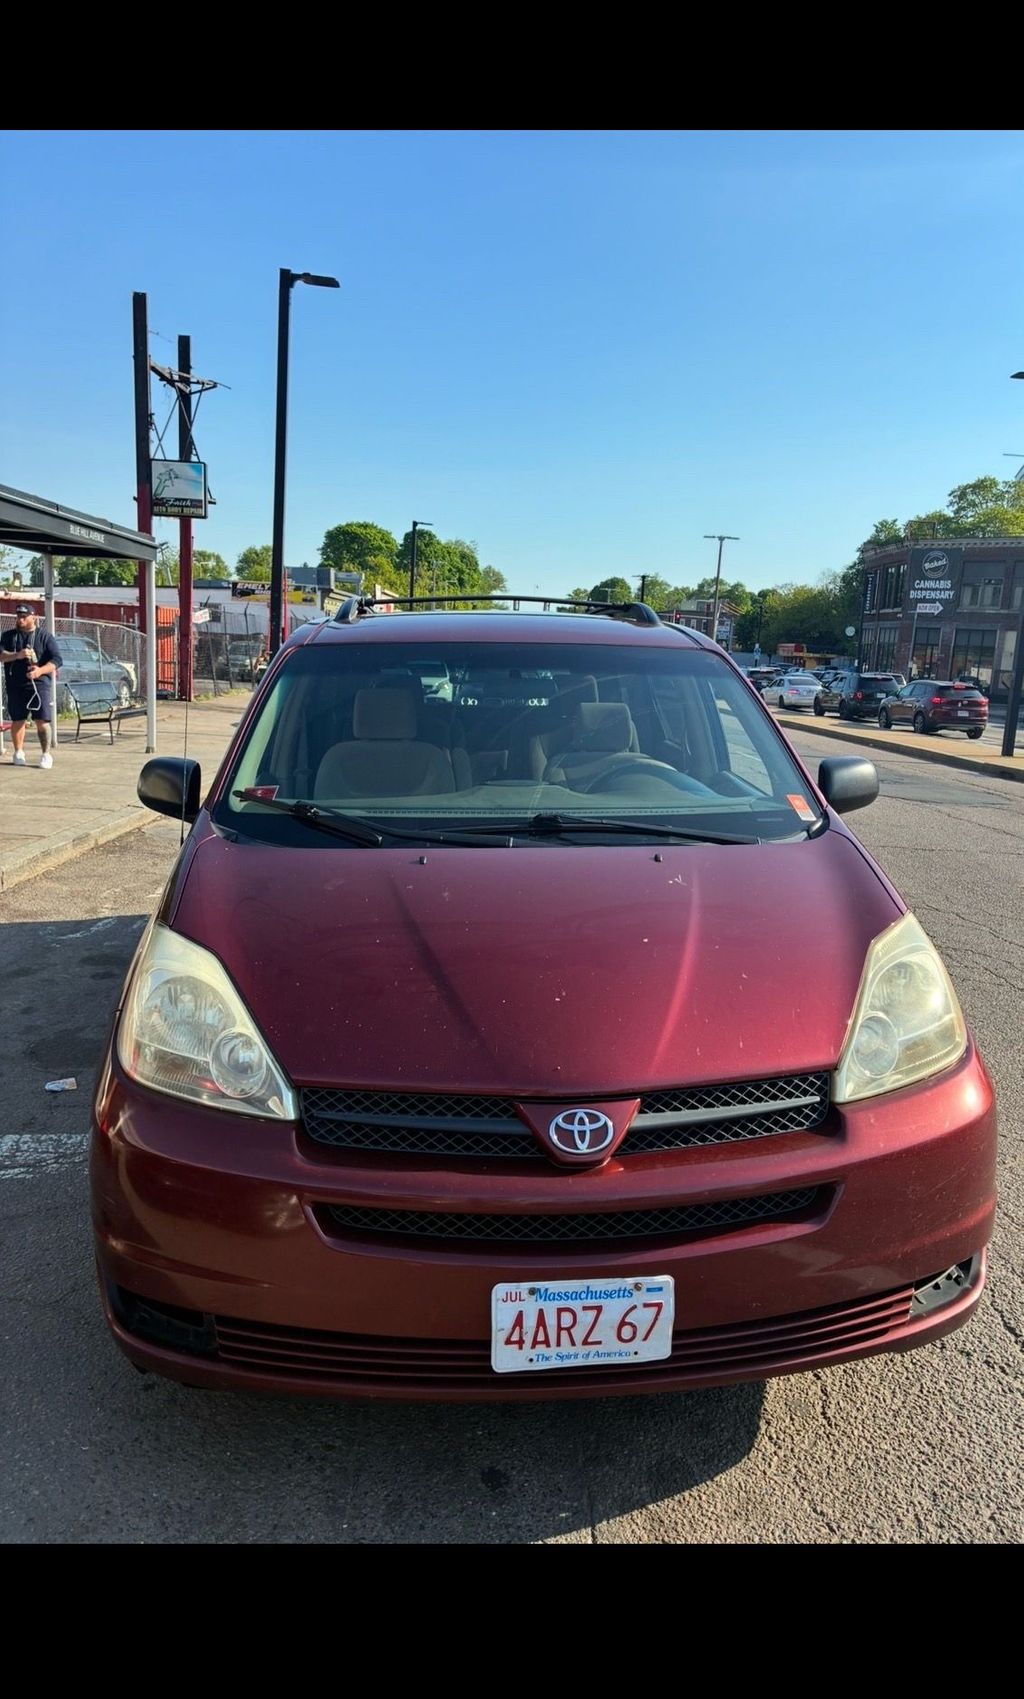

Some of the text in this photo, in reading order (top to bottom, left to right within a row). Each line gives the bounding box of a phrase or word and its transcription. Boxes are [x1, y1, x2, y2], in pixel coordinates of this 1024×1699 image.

[914, 579, 952, 589] CANNABIS
[909, 590, 955, 600] DISPENSARY
[501, 1291, 526, 1303] JUL
[535, 1285, 634, 1303] Massachusetts
[504, 1302, 664, 1351] 4ARZ 67
[535, 1349, 631, 1363] The Spirit of America
